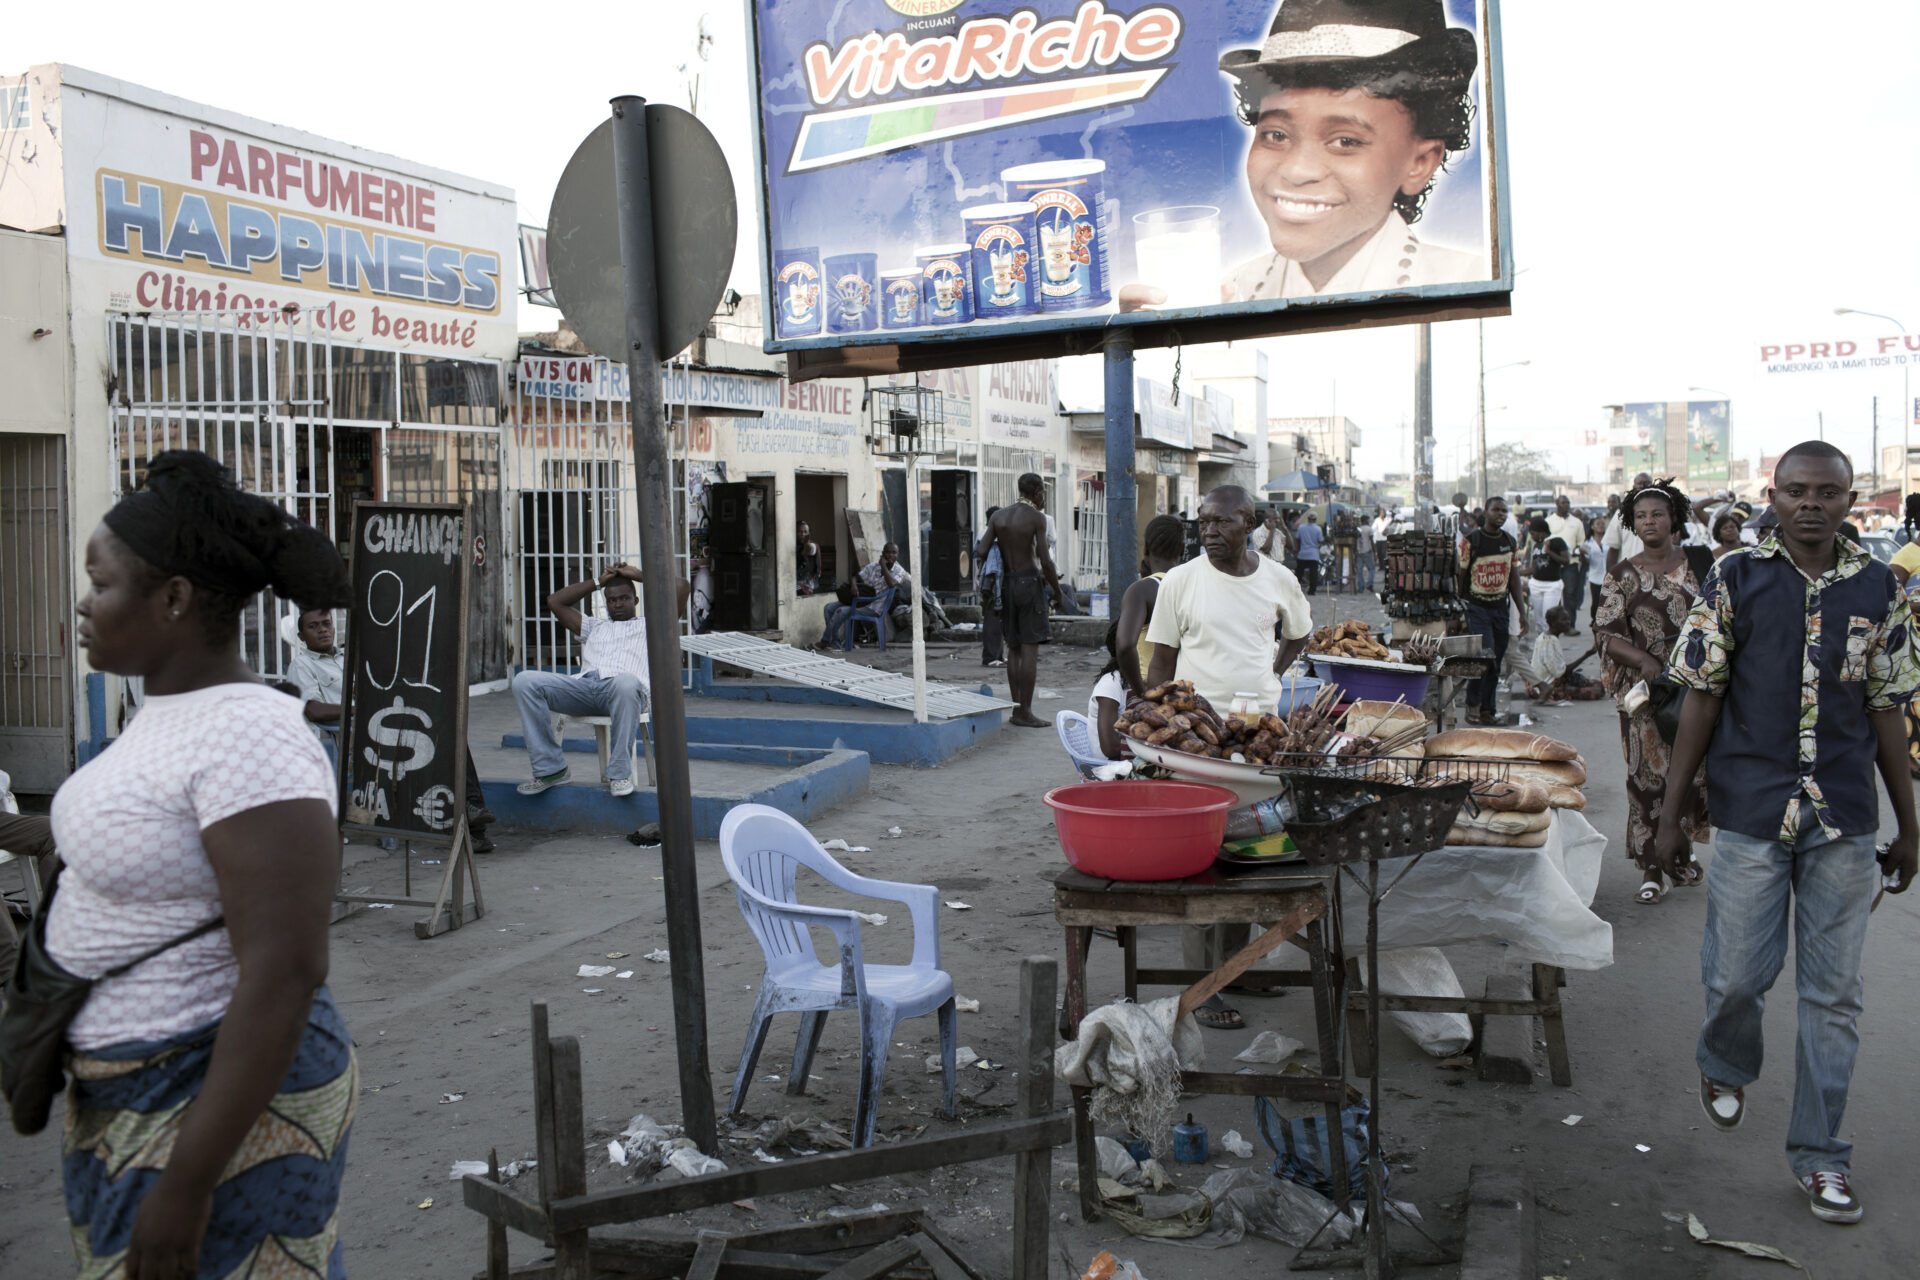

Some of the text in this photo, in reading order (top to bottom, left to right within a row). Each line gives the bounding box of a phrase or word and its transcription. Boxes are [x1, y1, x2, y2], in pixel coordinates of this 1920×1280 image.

[906, 16, 956, 31] INCLUANT
[805, 1, 1180, 104] VitaRiche
[189, 129, 436, 233] PARFUMERIE
[102, 174, 499, 310] HAPPINESS
[136, 271, 301, 329] Clinique
[316, 301, 356, 332] de
[371, 306, 478, 348] beauté
[1760, 341, 1858, 361] PPRD
[1767, 361, 1823, 374] MOMBONGO
[1826, 360, 1839, 370] YA
[524, 361, 593, 384] VISION
[527, 381, 584, 398] MUSIC
[701, 372, 779, 409] DISTRIBUTION
[788, 380, 852, 415] SERVICE
[511, 405, 587, 449] VENTE
[1478, 572, 1505, 585] TAMPA
[365, 569, 441, 692] 91
